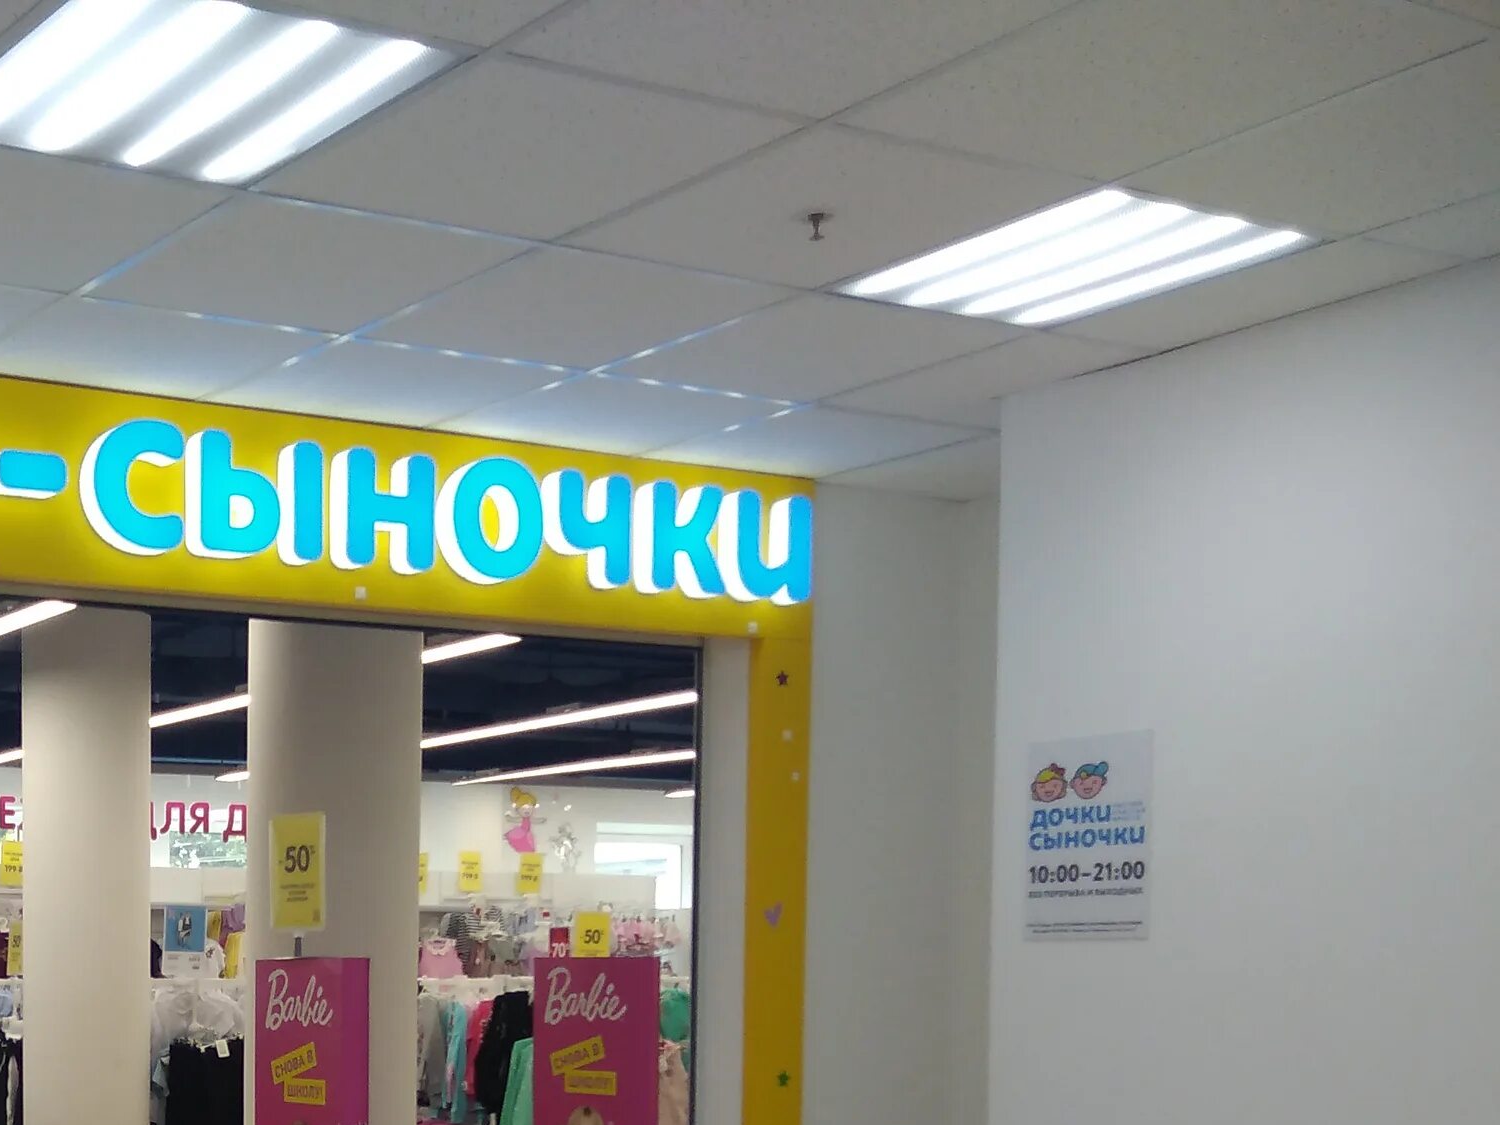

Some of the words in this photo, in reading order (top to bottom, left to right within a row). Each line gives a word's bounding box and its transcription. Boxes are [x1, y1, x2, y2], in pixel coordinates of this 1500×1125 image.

[1029, 826, 1145, 851] СЫНОЧКИ
[1030, 804, 1111, 831] ДОЧКИ
[265, 969, 333, 1031] Barbie
[544, 966, 627, 1026] Barbie
